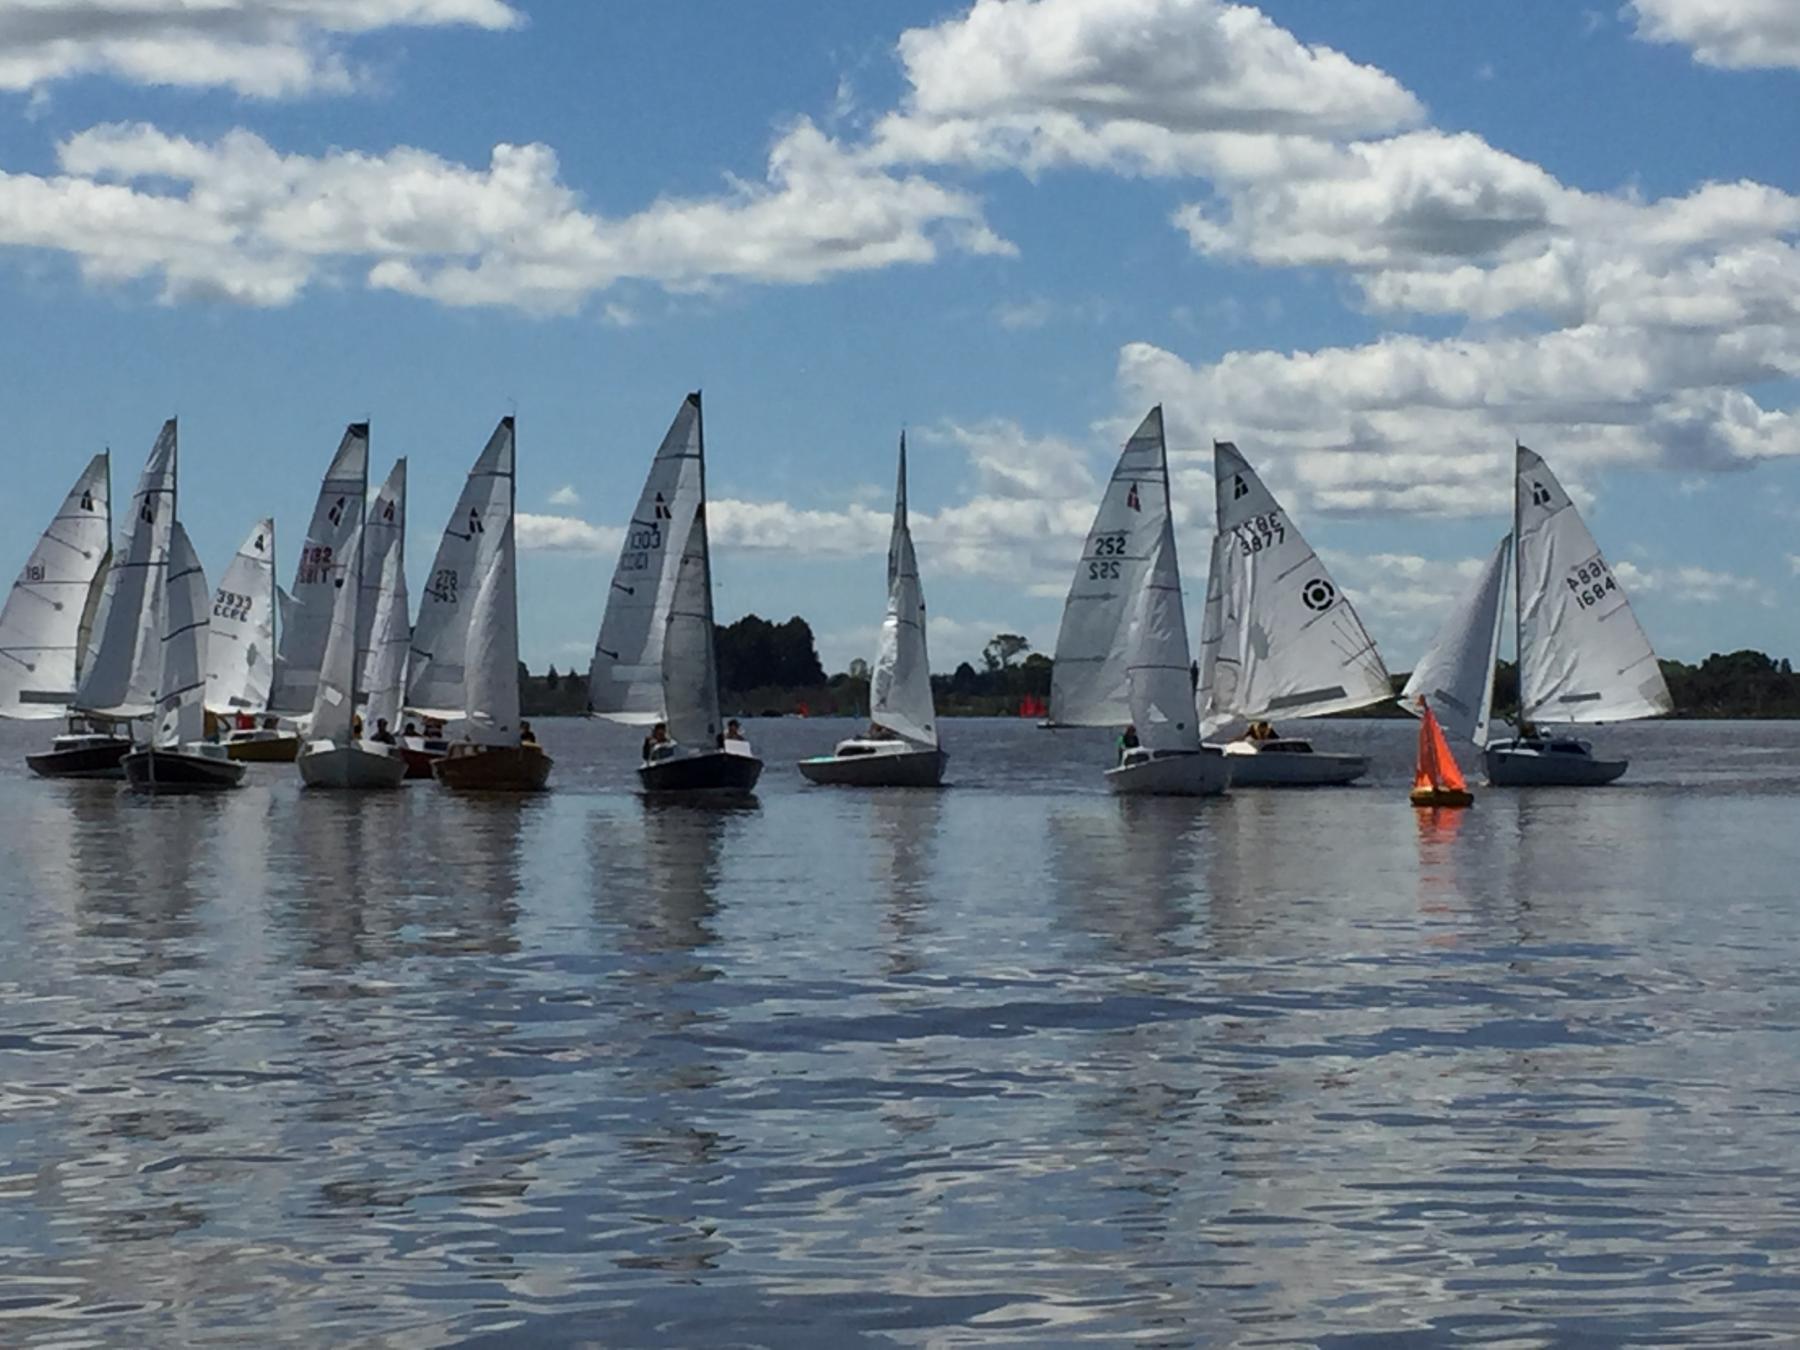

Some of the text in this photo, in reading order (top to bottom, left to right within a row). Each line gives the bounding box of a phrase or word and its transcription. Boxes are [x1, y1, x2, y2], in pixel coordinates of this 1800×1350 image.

[1095, 537, 1126, 555] 252
[1241, 527, 1284, 557] 3877
[216, 588, 252, 610] 3933
[1576, 576, 1616, 610] 1684
